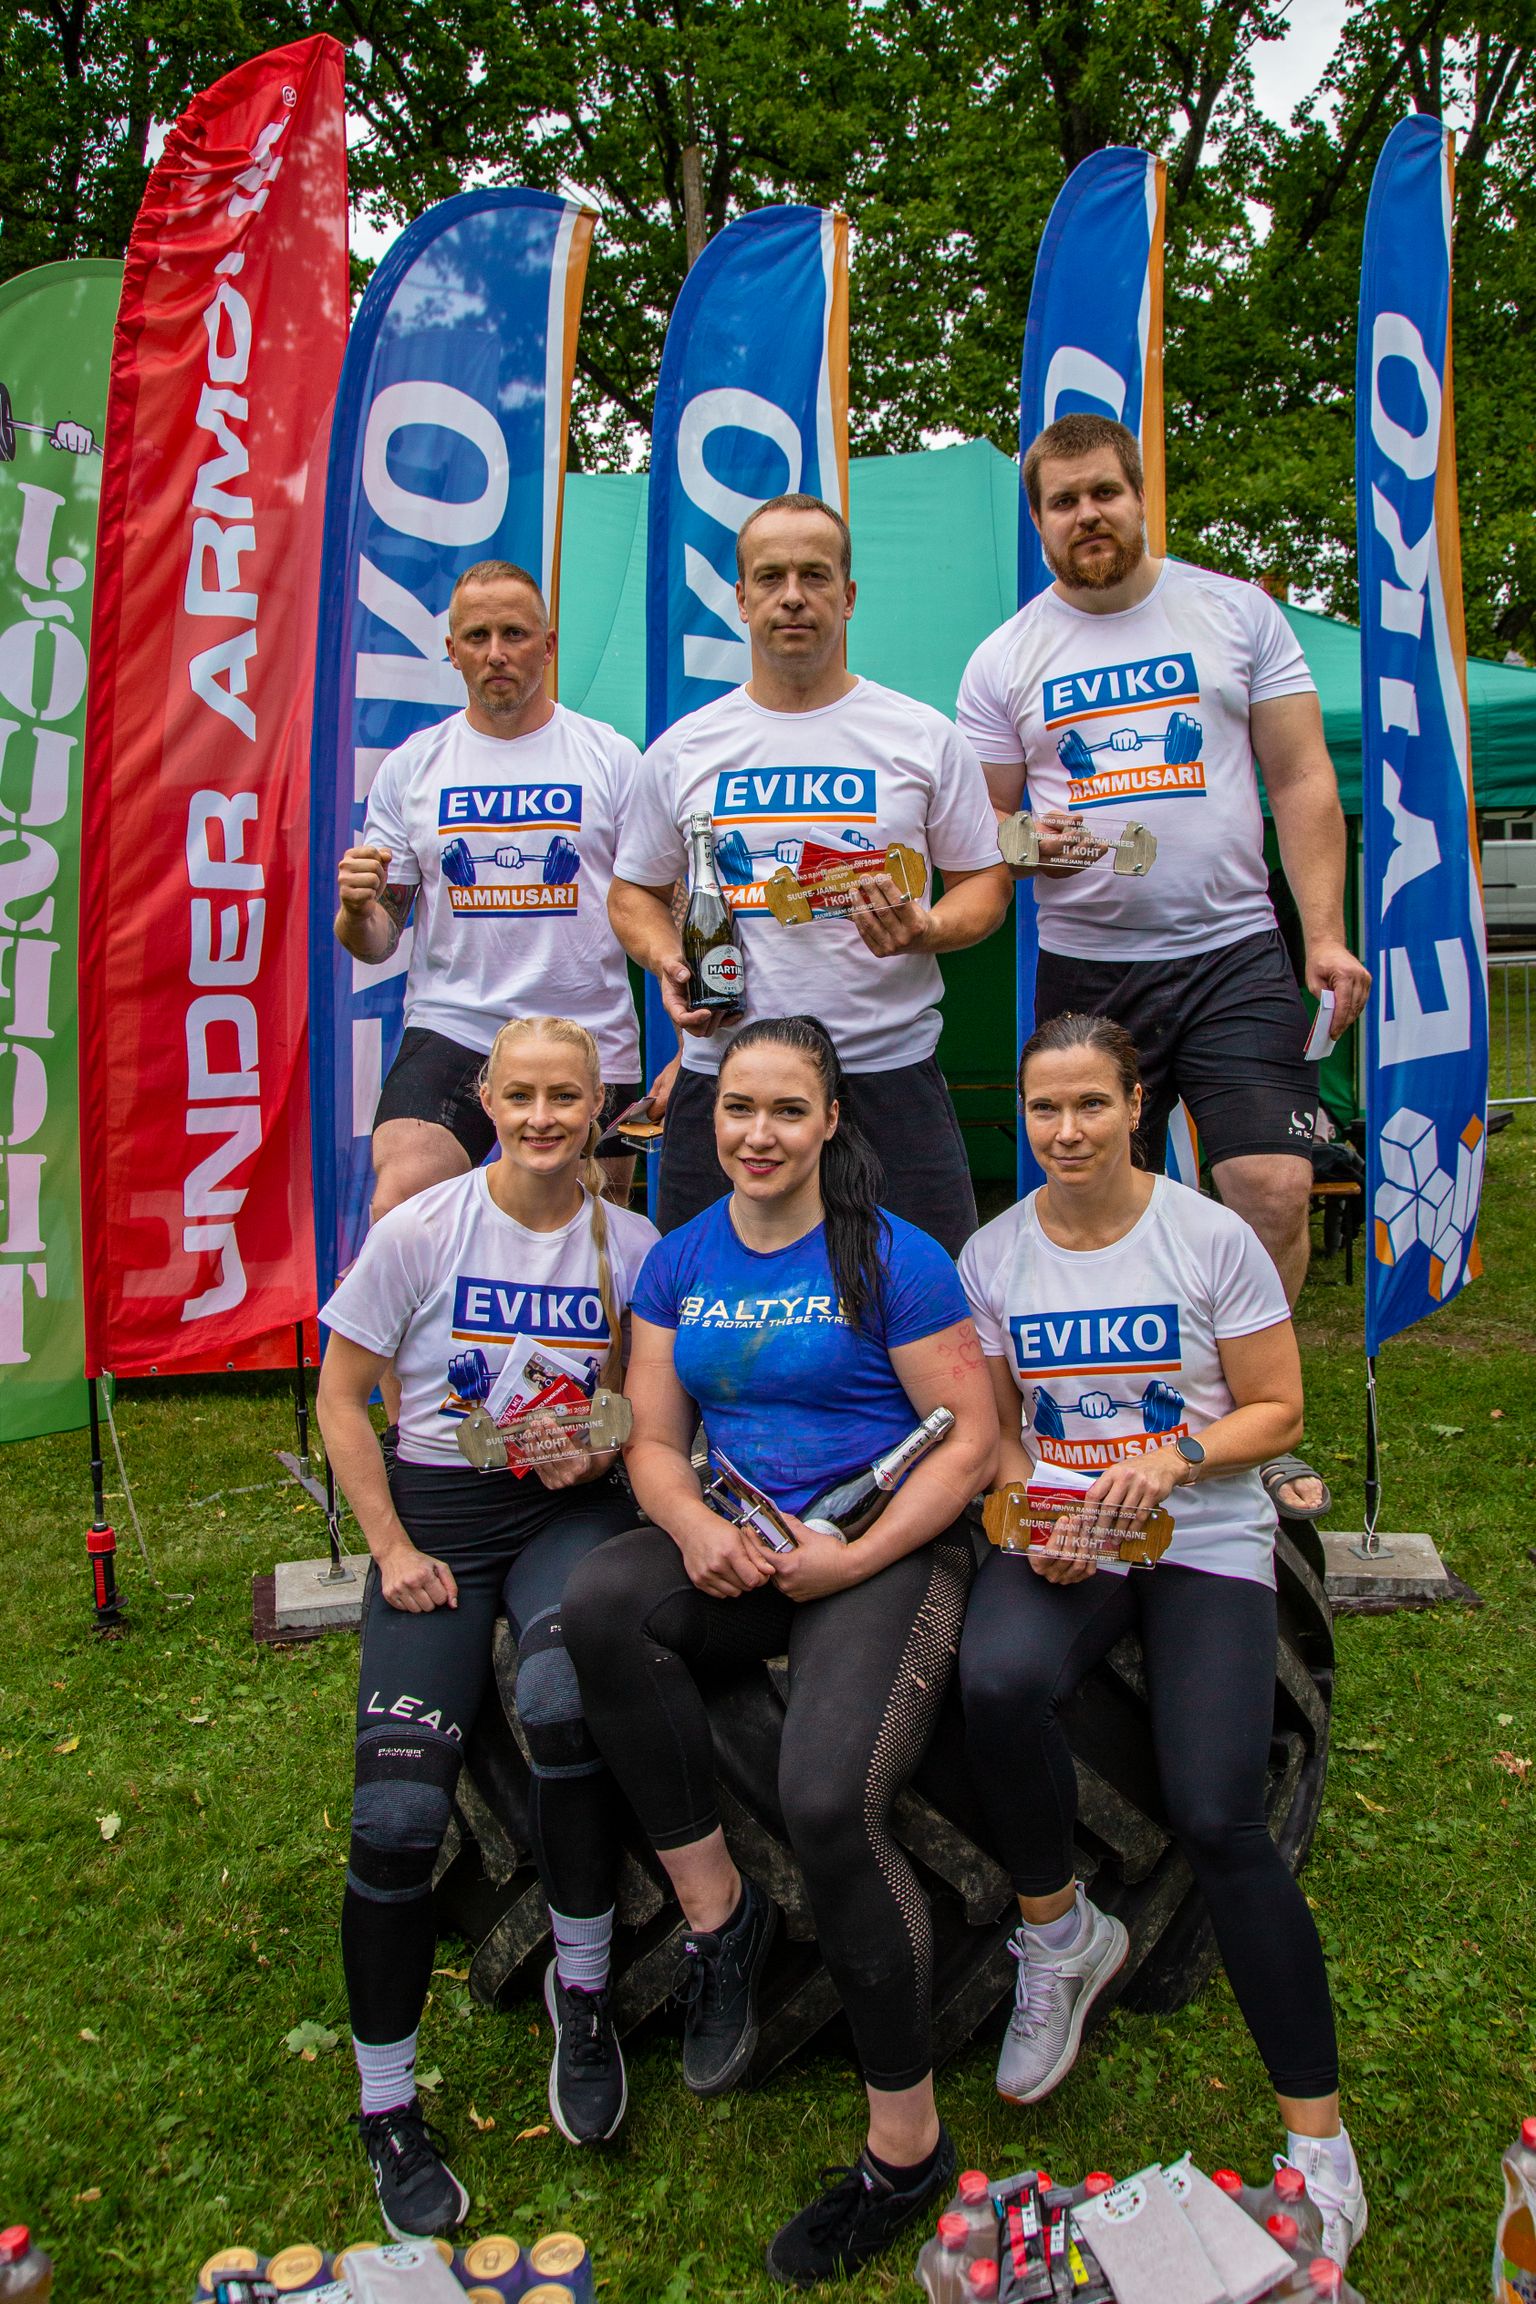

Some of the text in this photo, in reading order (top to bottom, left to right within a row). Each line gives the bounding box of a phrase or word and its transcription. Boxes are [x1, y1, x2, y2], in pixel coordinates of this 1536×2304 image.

[1053, 660, 1186, 712] EVIKO
[1371, 311, 1471, 1070] EVIKO
[724, 773, 865, 808] EVIKO
[1071, 766, 1202, 800] RAMMUSARI
[447, 788, 573, 818] EVIKO
[704, 835, 713, 868] ASTI
[1072, 846, 1101, 857] KOHT
[451, 887, 575, 907] RAMMUSARI
[831, 891, 858, 906] KOHT
[181, 790, 267, 1323] UNDER
[466, 1286, 604, 1330] EVIKO
[681, 1296, 846, 1320] BALTYR
[715, 1320, 764, 1329] ROTATE
[769, 1315, 813, 1328] THESE
[1020, 1313, 1168, 1359] EVIKO
[535, 1437, 568, 1450] KOHT
[902, 1433, 930, 1463] ASTI
[1119, 1511, 1137, 1520] 2022
[1056, 1536, 1106, 1549] III KOHT
[1084, 1526, 1148, 1541] RAMMUNAINE
